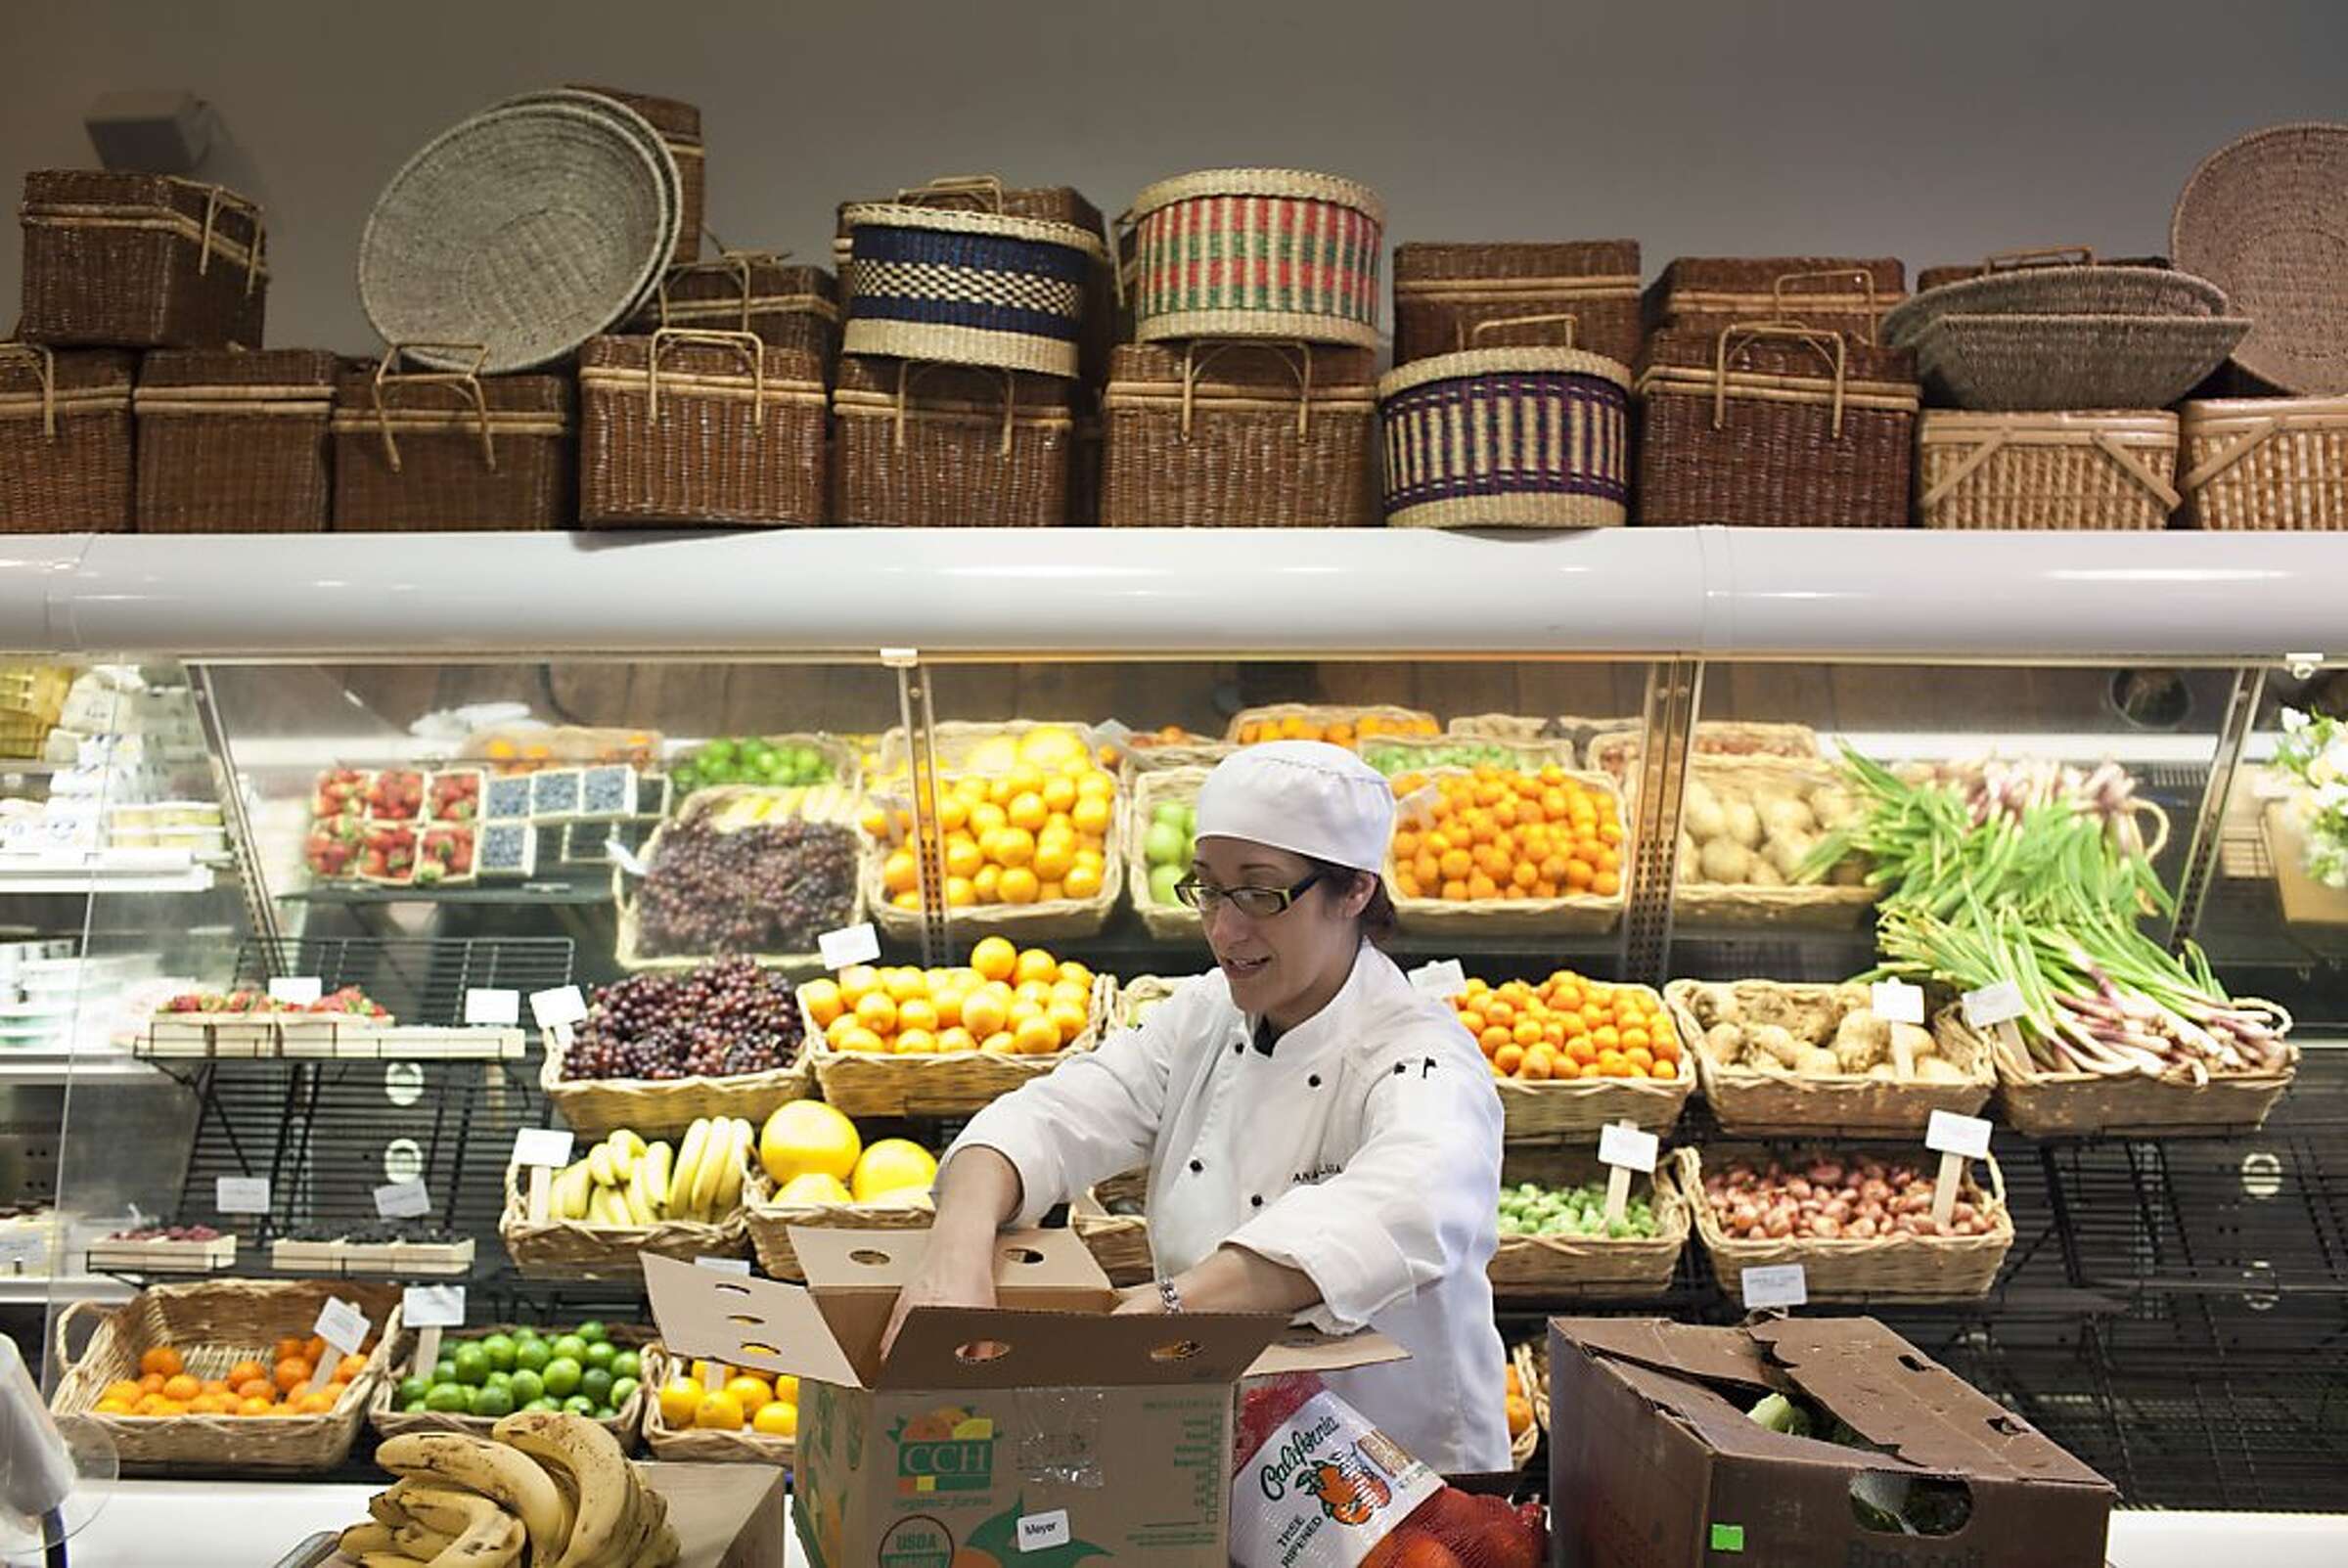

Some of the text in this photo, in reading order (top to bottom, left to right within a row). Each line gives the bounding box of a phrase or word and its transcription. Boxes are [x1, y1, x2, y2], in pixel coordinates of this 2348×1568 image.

[903, 1443, 988, 1474] CCH
[1260, 1415, 1340, 1501] California
[896, 1533, 937, 1550] USDA
[1023, 1520, 1058, 1536] Meyer
[1281, 1515, 1323, 1568] RIPENED
